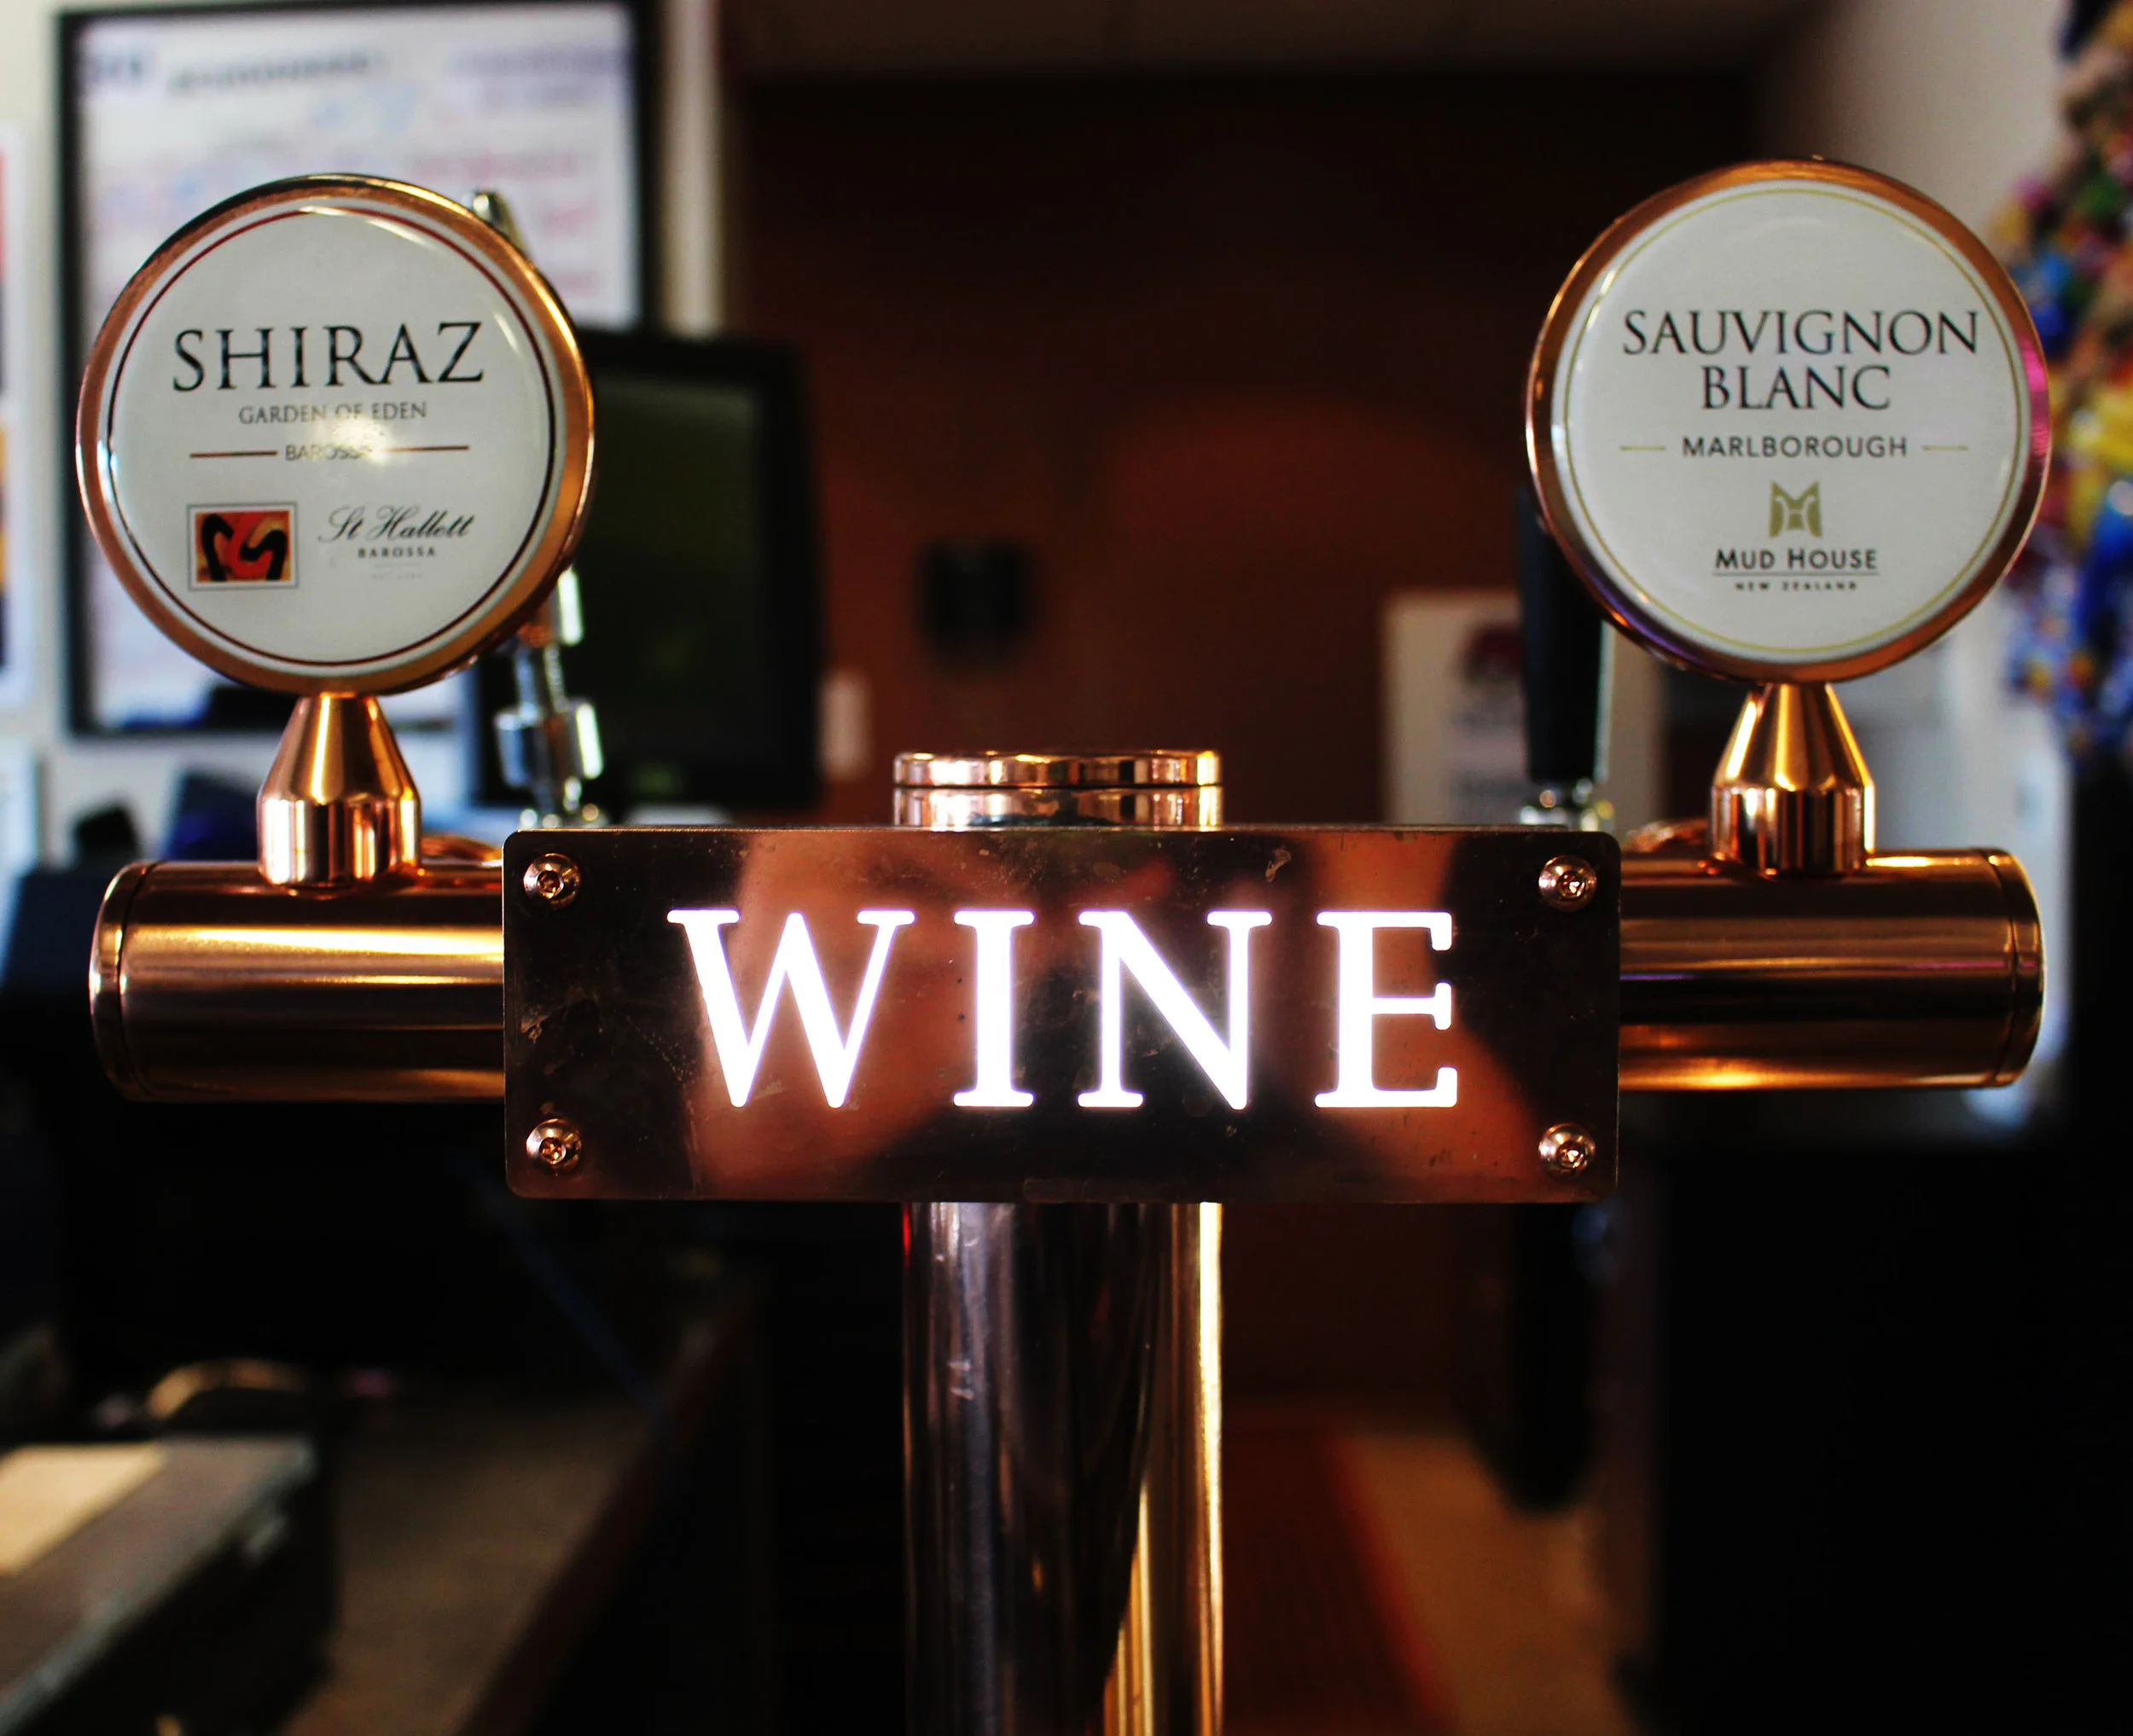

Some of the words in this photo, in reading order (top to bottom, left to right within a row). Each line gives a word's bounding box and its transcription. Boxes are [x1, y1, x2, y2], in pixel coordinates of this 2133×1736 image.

[1623, 310, 1979, 356] SAUVIGNON
[172, 321, 485, 392] SHIRAZ
[1700, 364, 1892, 411] BLANC
[238, 404, 327, 425] GARDEN
[334, 403, 363, 421] OF
[371, 401, 427, 421] EDEN
[1682, 434, 1908, 459] MARLBOROUGH
[317, 505, 366, 543] St
[365, 504, 475, 542] Hallett
[357, 546, 437, 559] BAROSSA
[1714, 548, 1776, 571] MUD
[1787, 547, 1877, 571] HOUSE
[1735, 581, 1770, 591] NEW
[1782, 580, 1857, 591] ZEALAND
[667, 909, 1458, 1110] WINE
